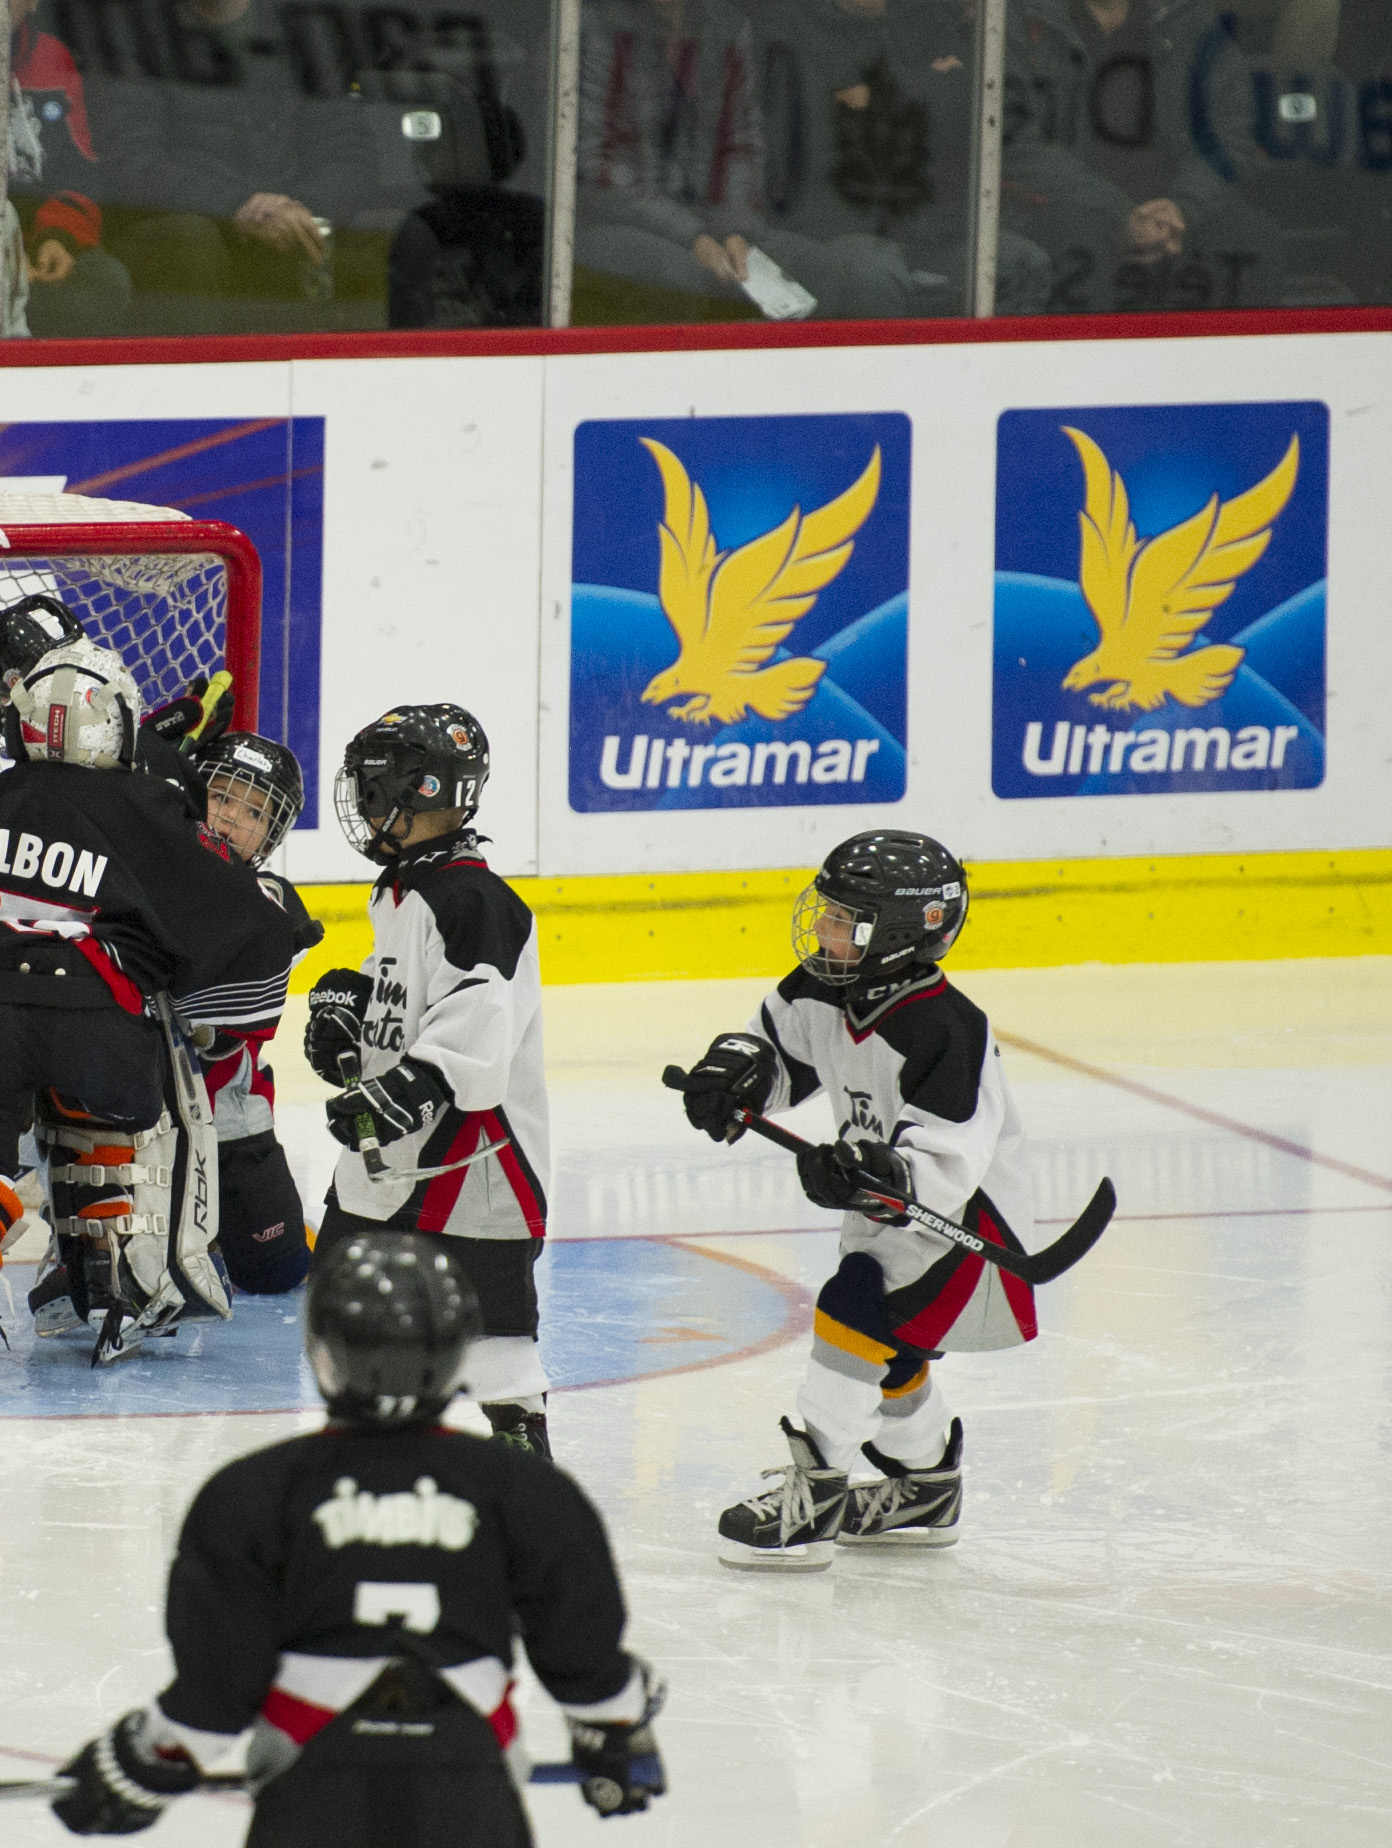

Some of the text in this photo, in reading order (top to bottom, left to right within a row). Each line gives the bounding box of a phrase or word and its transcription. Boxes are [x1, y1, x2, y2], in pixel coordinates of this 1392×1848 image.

[600, 734, 879, 790] Ultramar
[1022, 721, 1298, 776] Ultramar
[455, 779, 476, 807] 12
[894, 887, 942, 896] BAUER
[310, 988, 358, 1008] Reebok
[906, 1203, 985, 1252] SHER-WOOD
